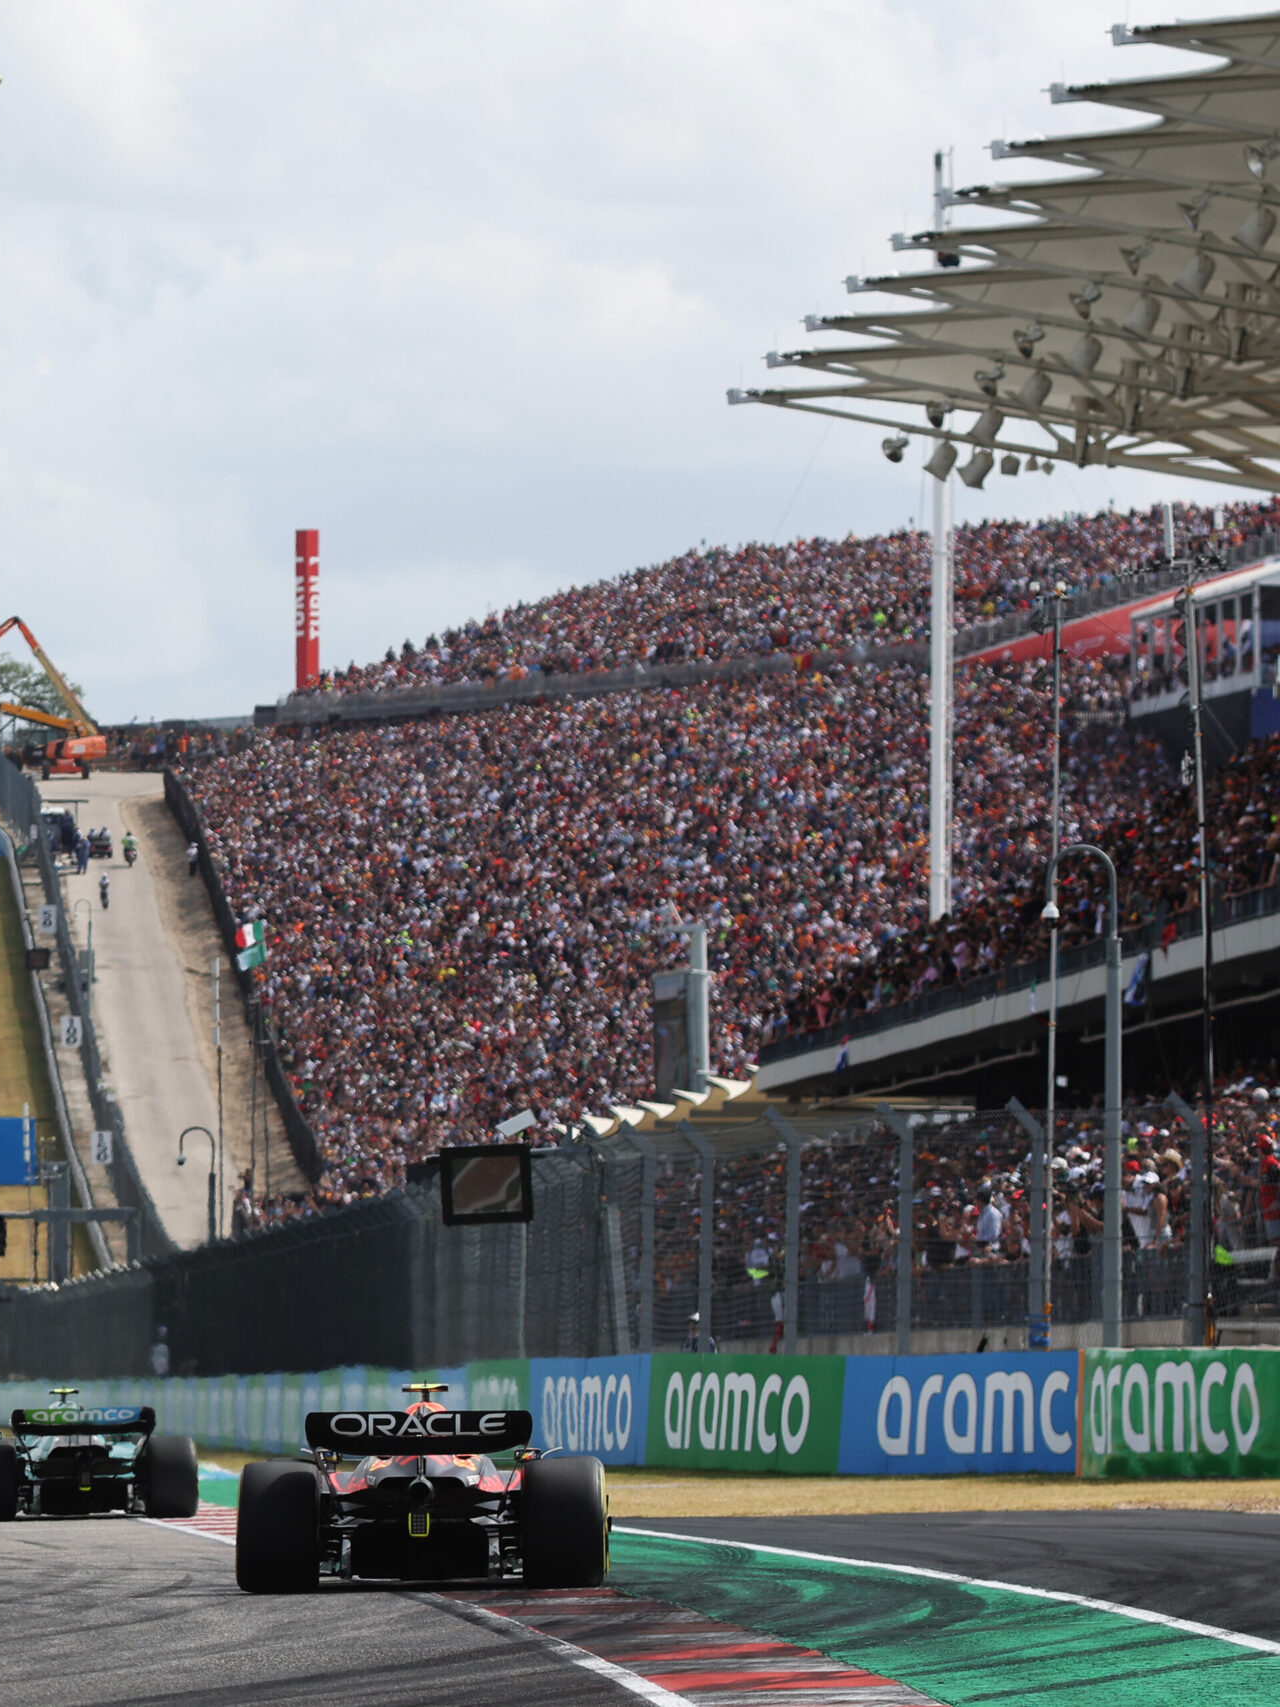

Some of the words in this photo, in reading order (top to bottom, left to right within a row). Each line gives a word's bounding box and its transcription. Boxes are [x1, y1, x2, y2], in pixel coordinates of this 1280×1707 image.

[32, 1409, 135, 1422] aramco
[330, 1413, 508, 1437] ORACLE
[542, 1374, 632, 1451] aramco
[664, 1371, 811, 1455] aramco
[877, 1370, 1078, 1456] aramc
[1090, 1361, 1261, 1456] aramco
